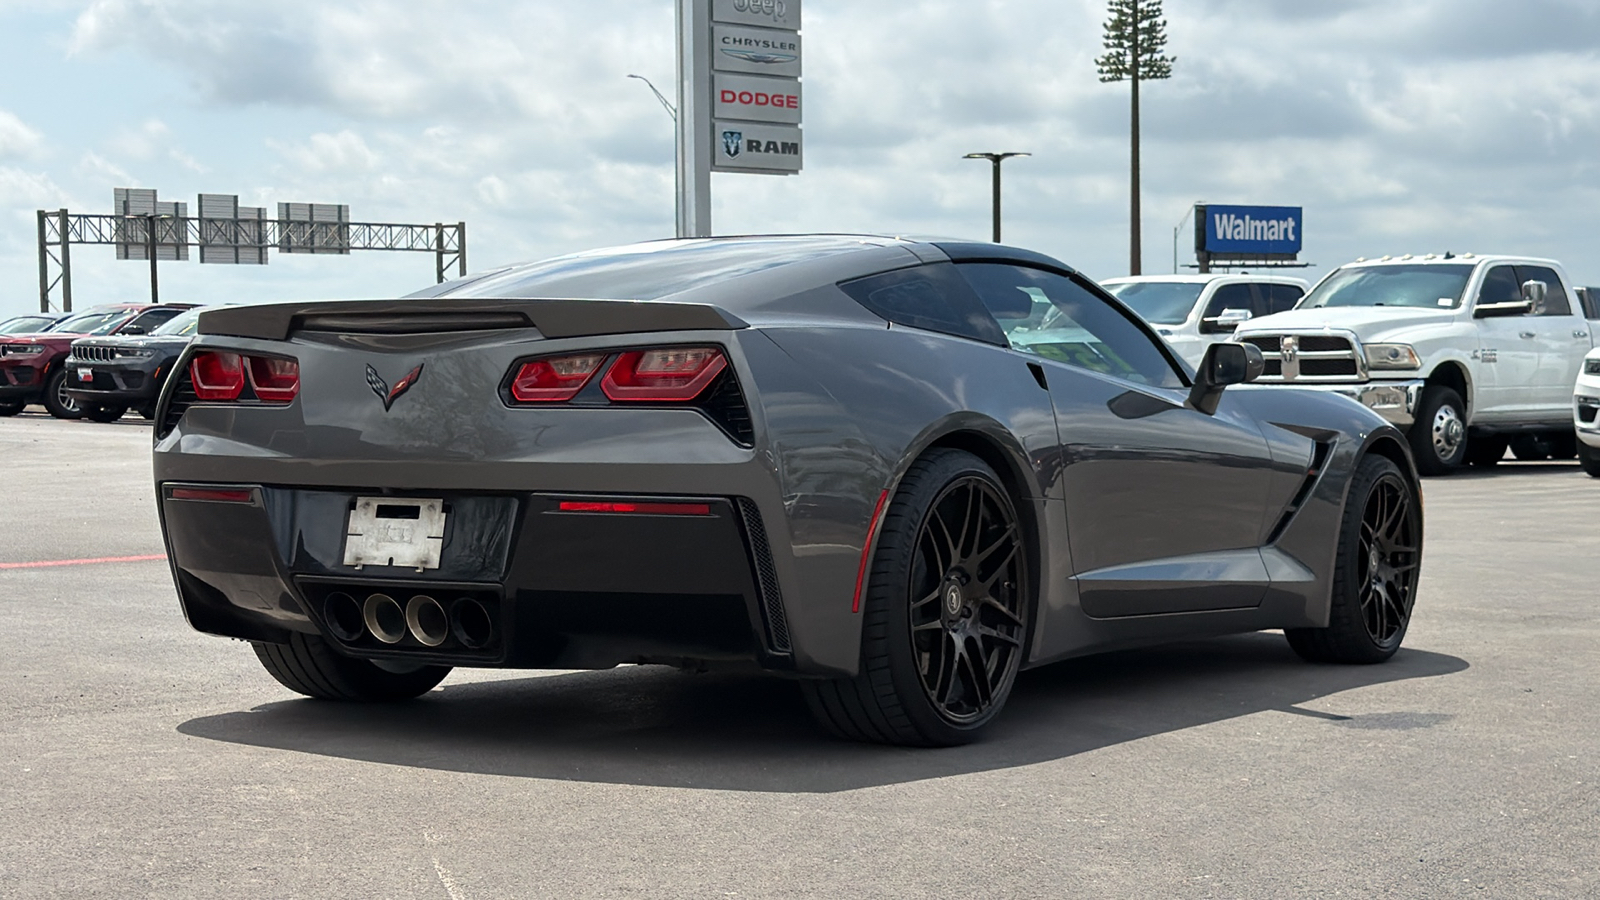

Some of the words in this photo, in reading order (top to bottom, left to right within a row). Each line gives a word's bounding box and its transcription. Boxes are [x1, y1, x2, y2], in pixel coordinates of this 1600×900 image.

[722, 36, 796, 51] CHRYSLER
[720, 90, 799, 109] DODGE
[746, 139, 799, 155] RAM
[1214, 213, 1296, 241] Walmart
